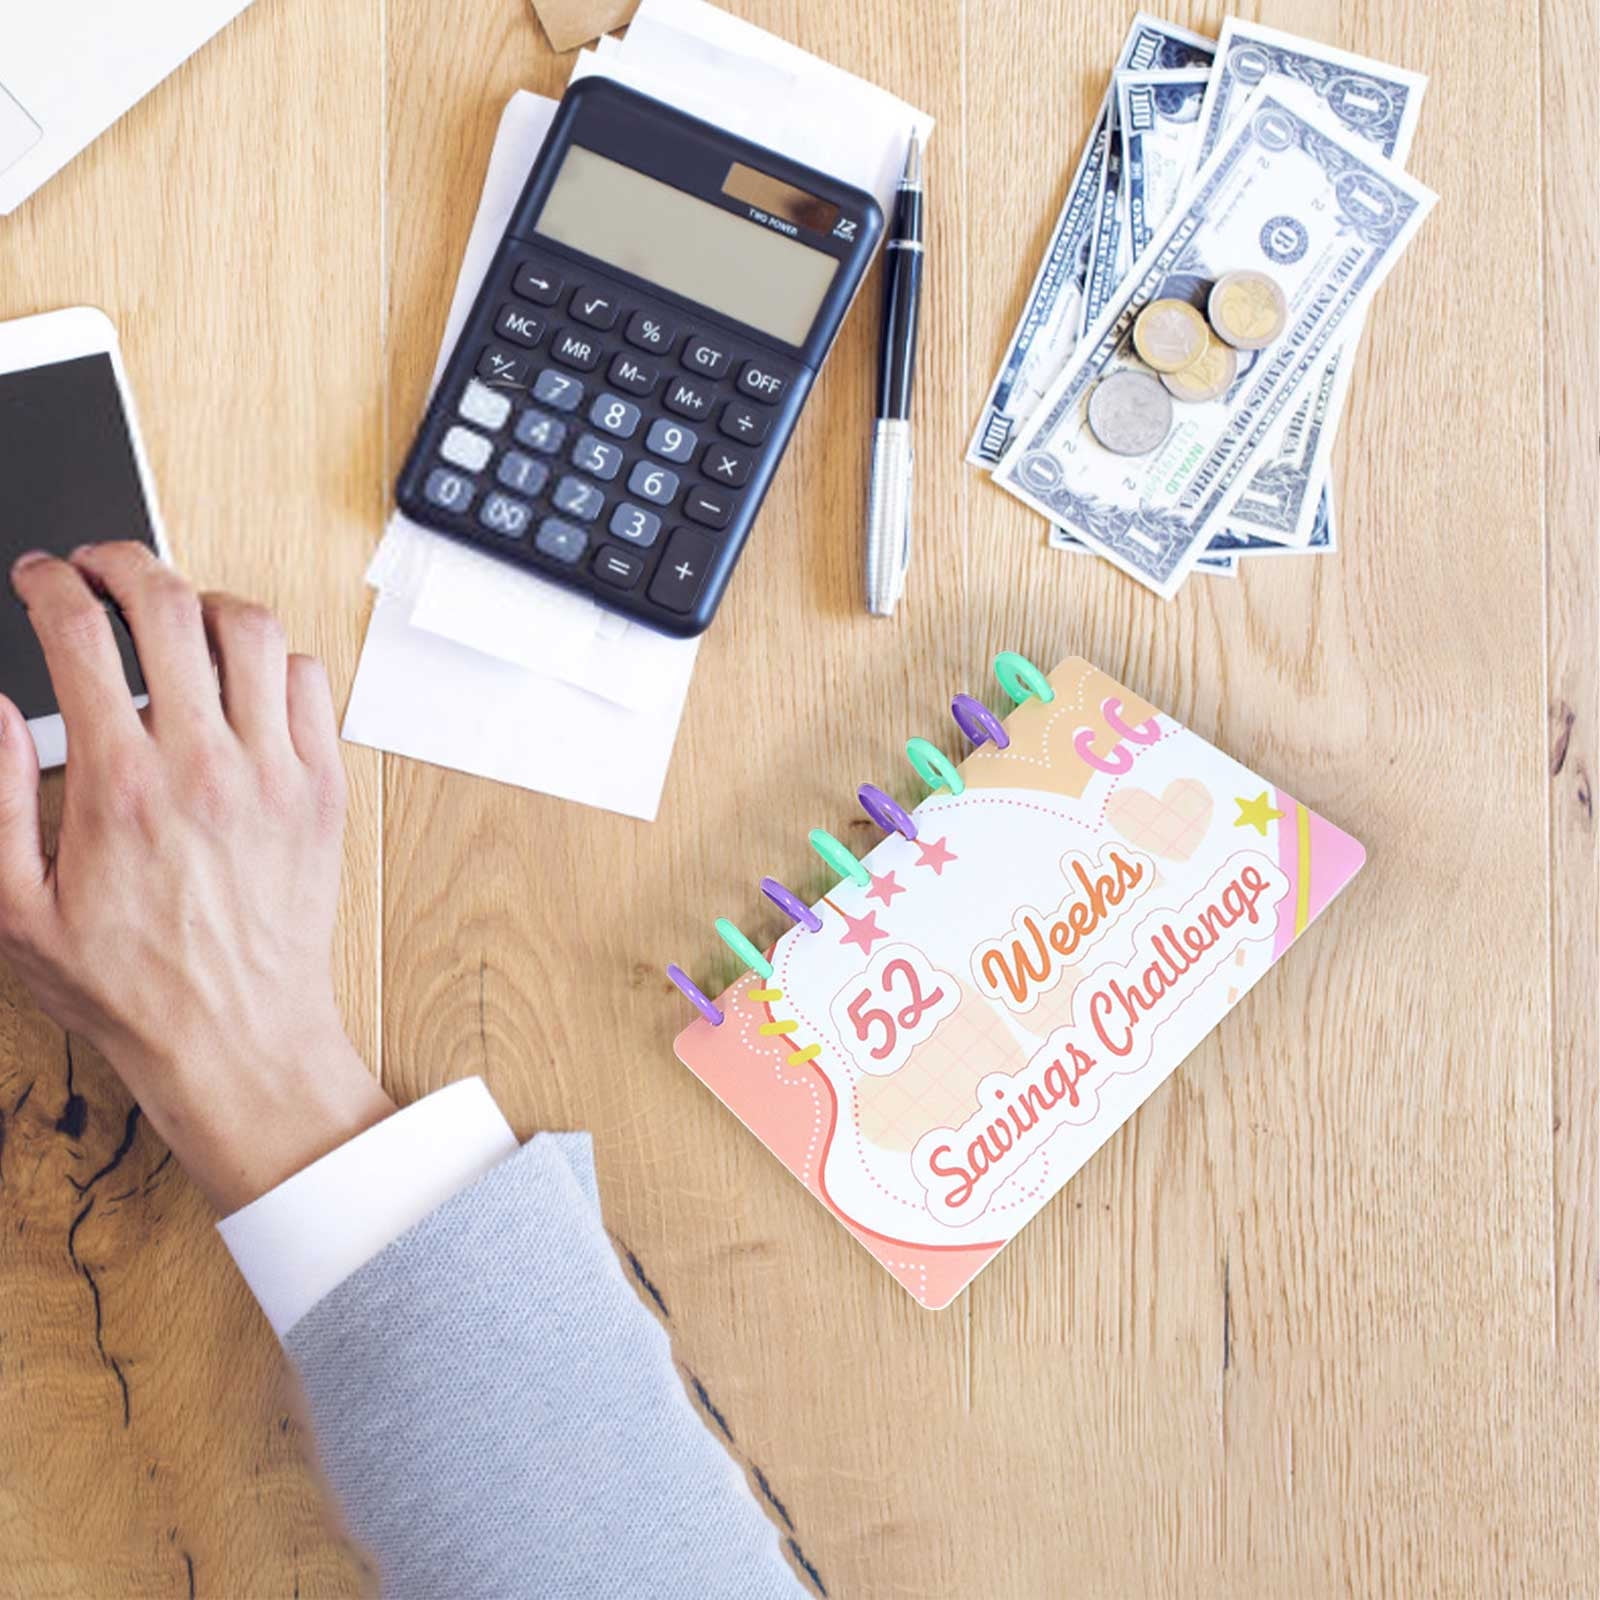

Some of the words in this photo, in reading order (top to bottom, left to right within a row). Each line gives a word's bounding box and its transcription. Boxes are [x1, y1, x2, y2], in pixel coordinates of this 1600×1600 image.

[768, 217, 798, 237] POWER
[1331, 243, 1365, 284] THE
[506, 313, 535, 338] MC
[1288, 281, 1339, 348] UNITED
[562, 337, 591, 362] MR
[696, 346, 721, 368] GT
[552, 376, 570, 399] 7
[747, 369, 780, 394] OFF
[1245, 344, 1296, 411] STATES
[675, 387, 703, 409] M+
[604, 403, 623, 428] 8
[1230, 408, 1255, 436] OF
[530, 422, 550, 445] 4
[665, 428, 682, 453] 9
[589, 445, 609, 470] 5
[1162, 441, 1206, 497] INVALID
[643, 472, 662, 495] 6
[1178, 433, 1238, 513] AMERICA
[568, 488, 587, 512] 2
[624, 513, 642, 537] 3
[845, 959, 945, 1060] 52
[980, 851, 1143, 1006] Weeks
[929, 1042, 1097, 1209] Savings
[1089, 865, 1270, 1057] Challenge
